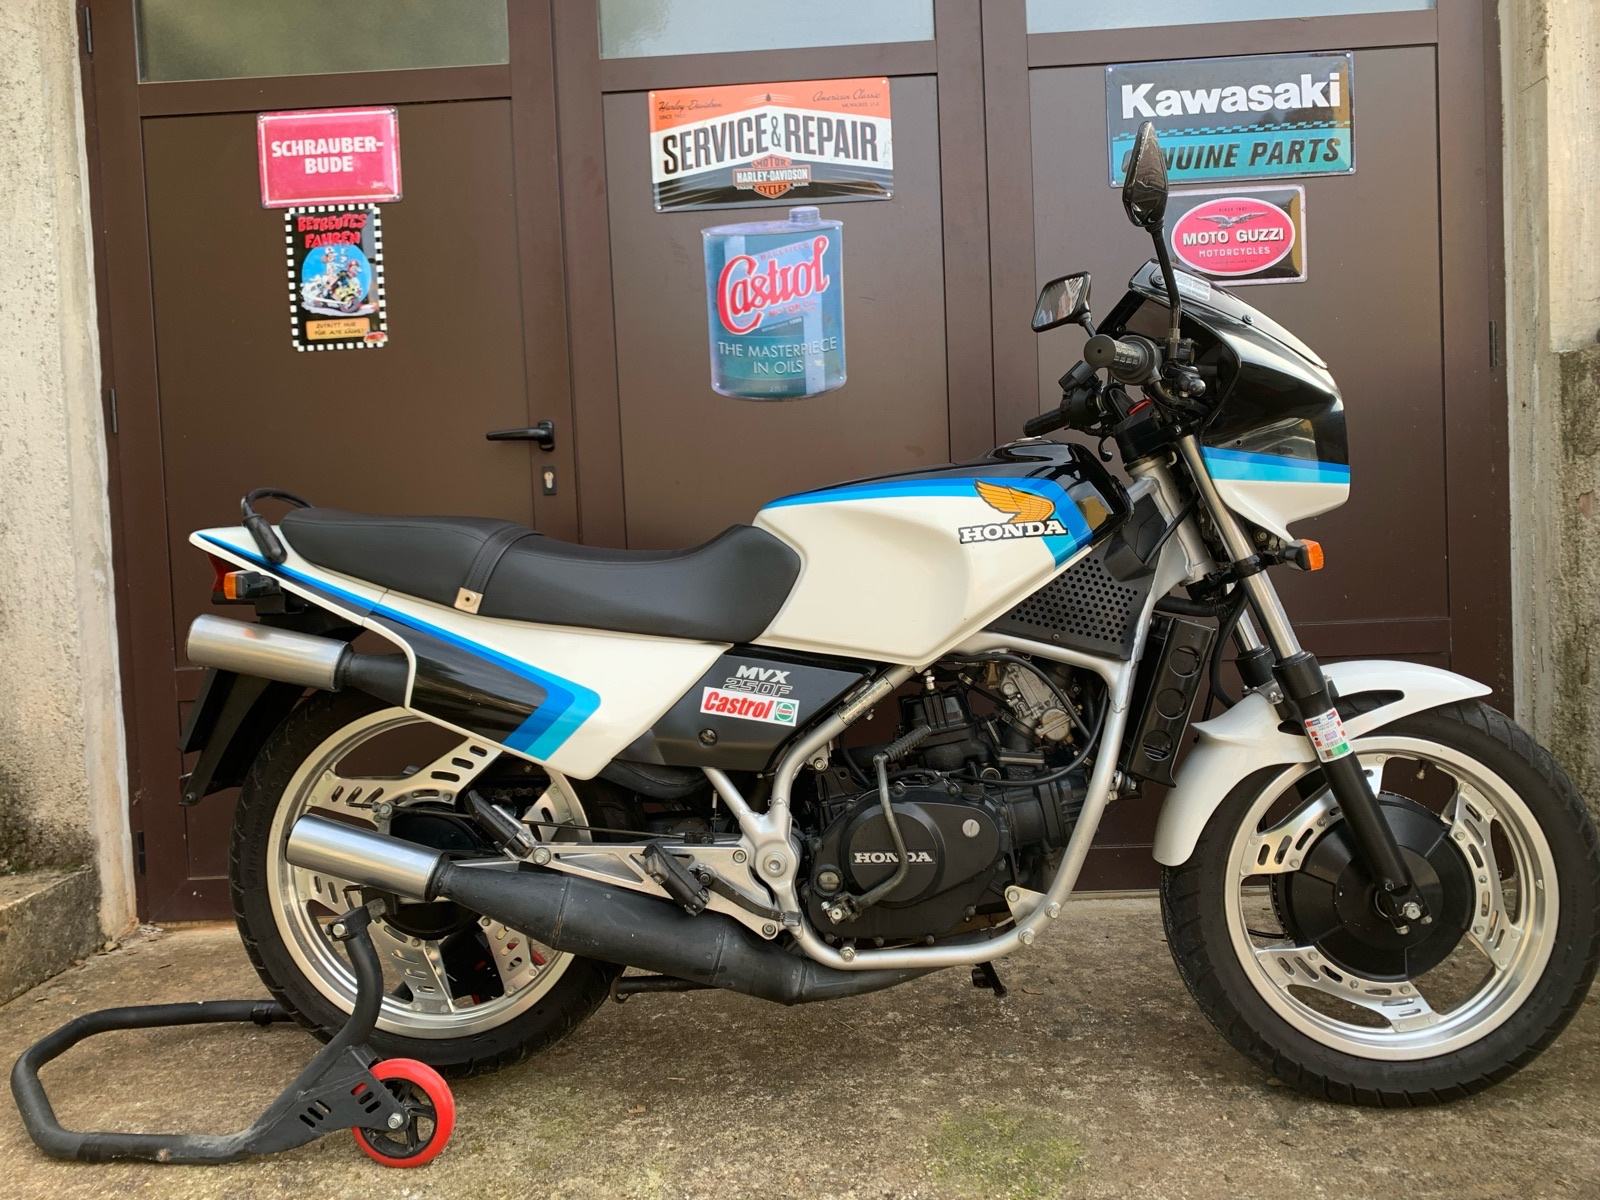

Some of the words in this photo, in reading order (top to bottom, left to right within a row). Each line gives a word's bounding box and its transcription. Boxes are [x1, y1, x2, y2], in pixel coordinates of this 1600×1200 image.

[1121, 72, 1340, 119] Kawasaki
[271, 136, 384, 158] SCHRAUBER-
[662, 112, 768, 175] SERVICE
[770, 115, 782, 148] &
[783, 112, 879, 162] REPAIR
[304, 156, 354, 174] BUDE
[753, 156, 788, 168] MOTOR
[1121, 143, 1240, 173] NUINE
[1248, 138, 1341, 167] PARTS
[736, 168, 808, 183] HARLEY-DAVIDSON
[758, 184, 787, 195] CYCLES
[305, 230, 361, 248] FAHREN
[1182, 231, 1229, 246] MOTO
[1236, 228, 1284, 243] GUZZI
[1199, 246, 1271, 258] MOTORCYCLES
[717, 235, 830, 334] Castrol
[717, 341, 743, 357] THE
[747, 336, 837, 358] MASTERPIECE
[753, 361, 769, 374] IN
[774, 360, 804, 374] OILS
[959, 519, 1068, 544] HONDA
[735, 665, 791, 684] MVX
[723, 677, 794, 697] 250F
[704, 691, 775, 719] Castrol
